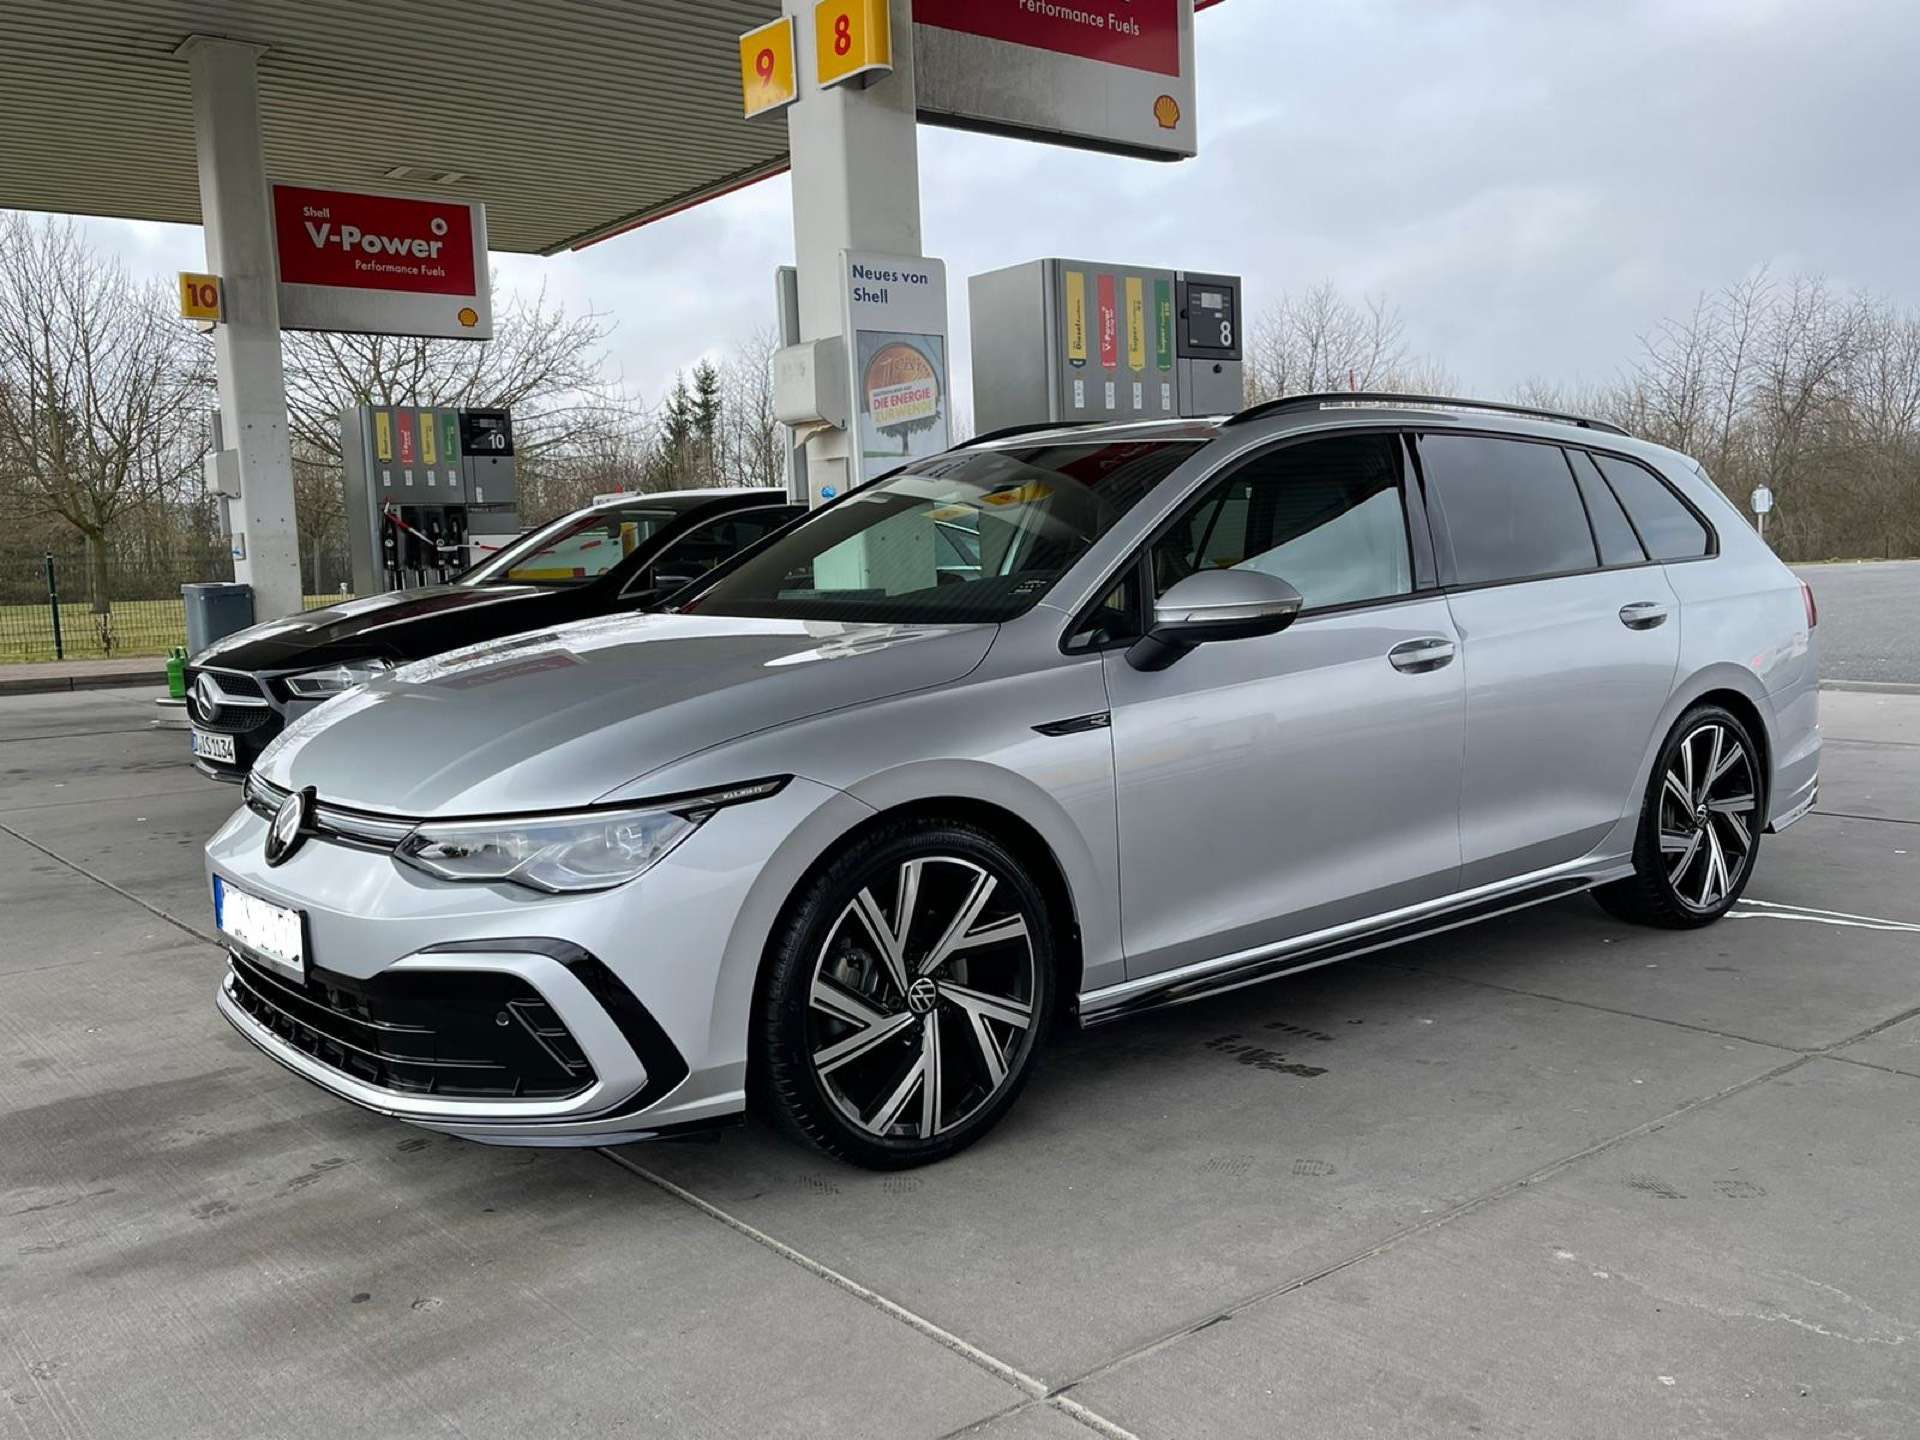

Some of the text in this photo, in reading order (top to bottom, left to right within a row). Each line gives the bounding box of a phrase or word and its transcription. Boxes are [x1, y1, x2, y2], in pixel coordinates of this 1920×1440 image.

[834, 14, 852, 56] 8
[1107, 12, 1140, 37] Fuels
[755, 48, 775, 89] 9
[303, 206, 331, 219] Shell
[304, 221, 443, 259] V-Power
[355, 259, 446, 277] Performance Fuels
[852, 264, 928, 285] Neues von
[187, 283, 218, 308] 10
[853, 287, 888, 305] Shell
[1220, 321, 1232, 347] 8
[873, 396, 889, 410] DIE
[890, 387, 932, 407] ENERGIE
[488, 433, 505, 449] 10
